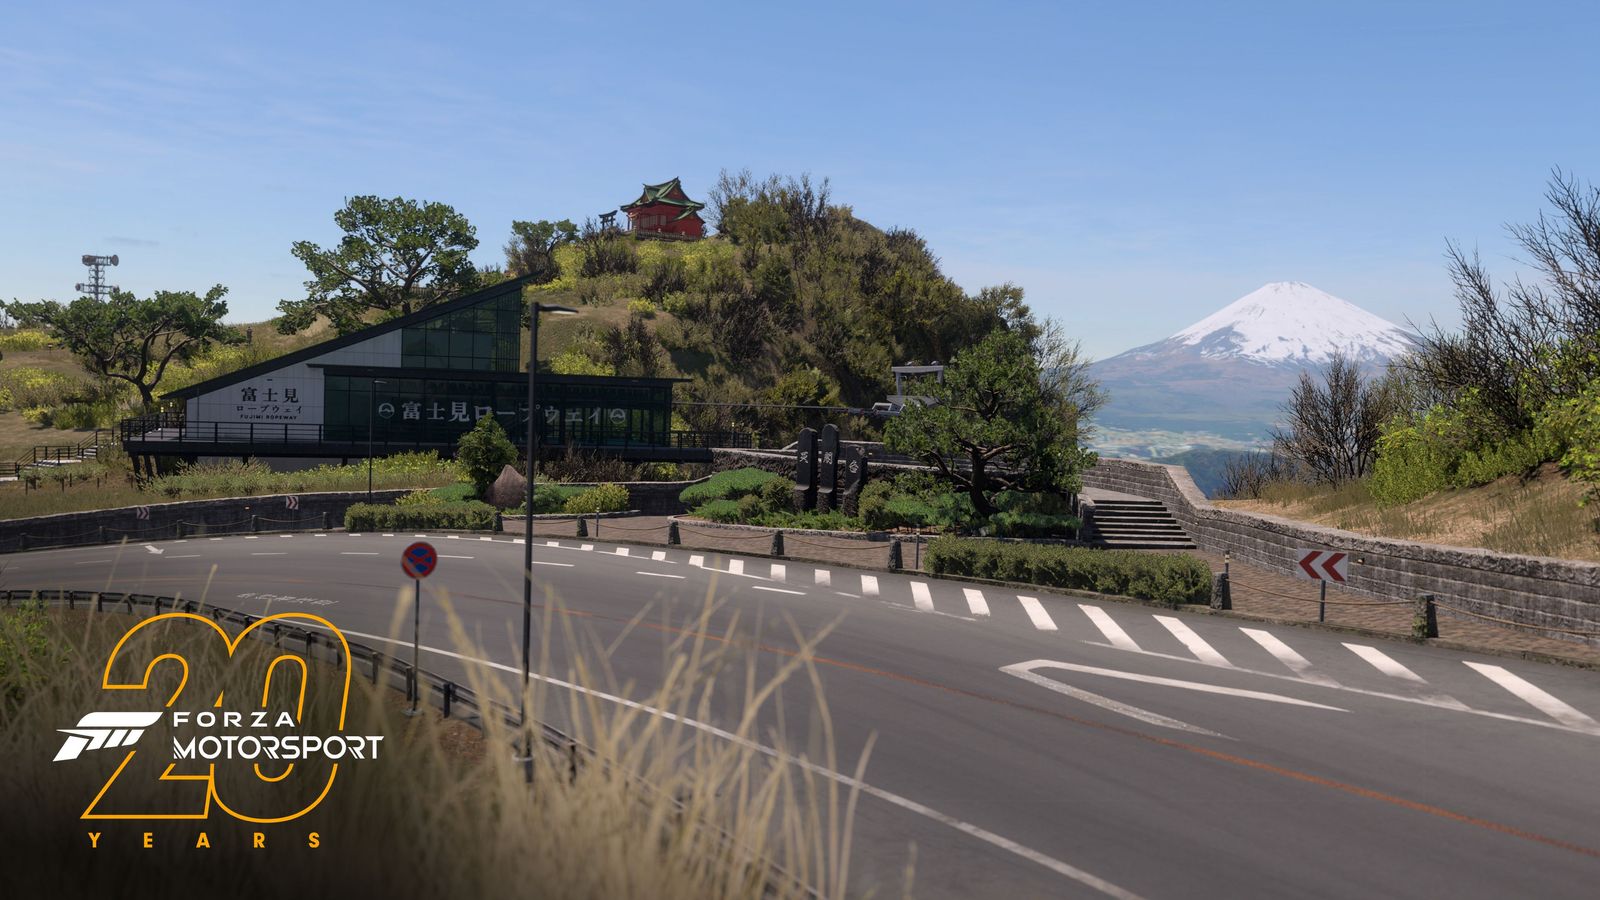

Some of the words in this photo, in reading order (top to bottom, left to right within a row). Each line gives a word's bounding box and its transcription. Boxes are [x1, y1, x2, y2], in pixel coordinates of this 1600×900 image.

[241, 387, 299, 403] 富士見
[236, 405, 302, 414] ロープウェイ
